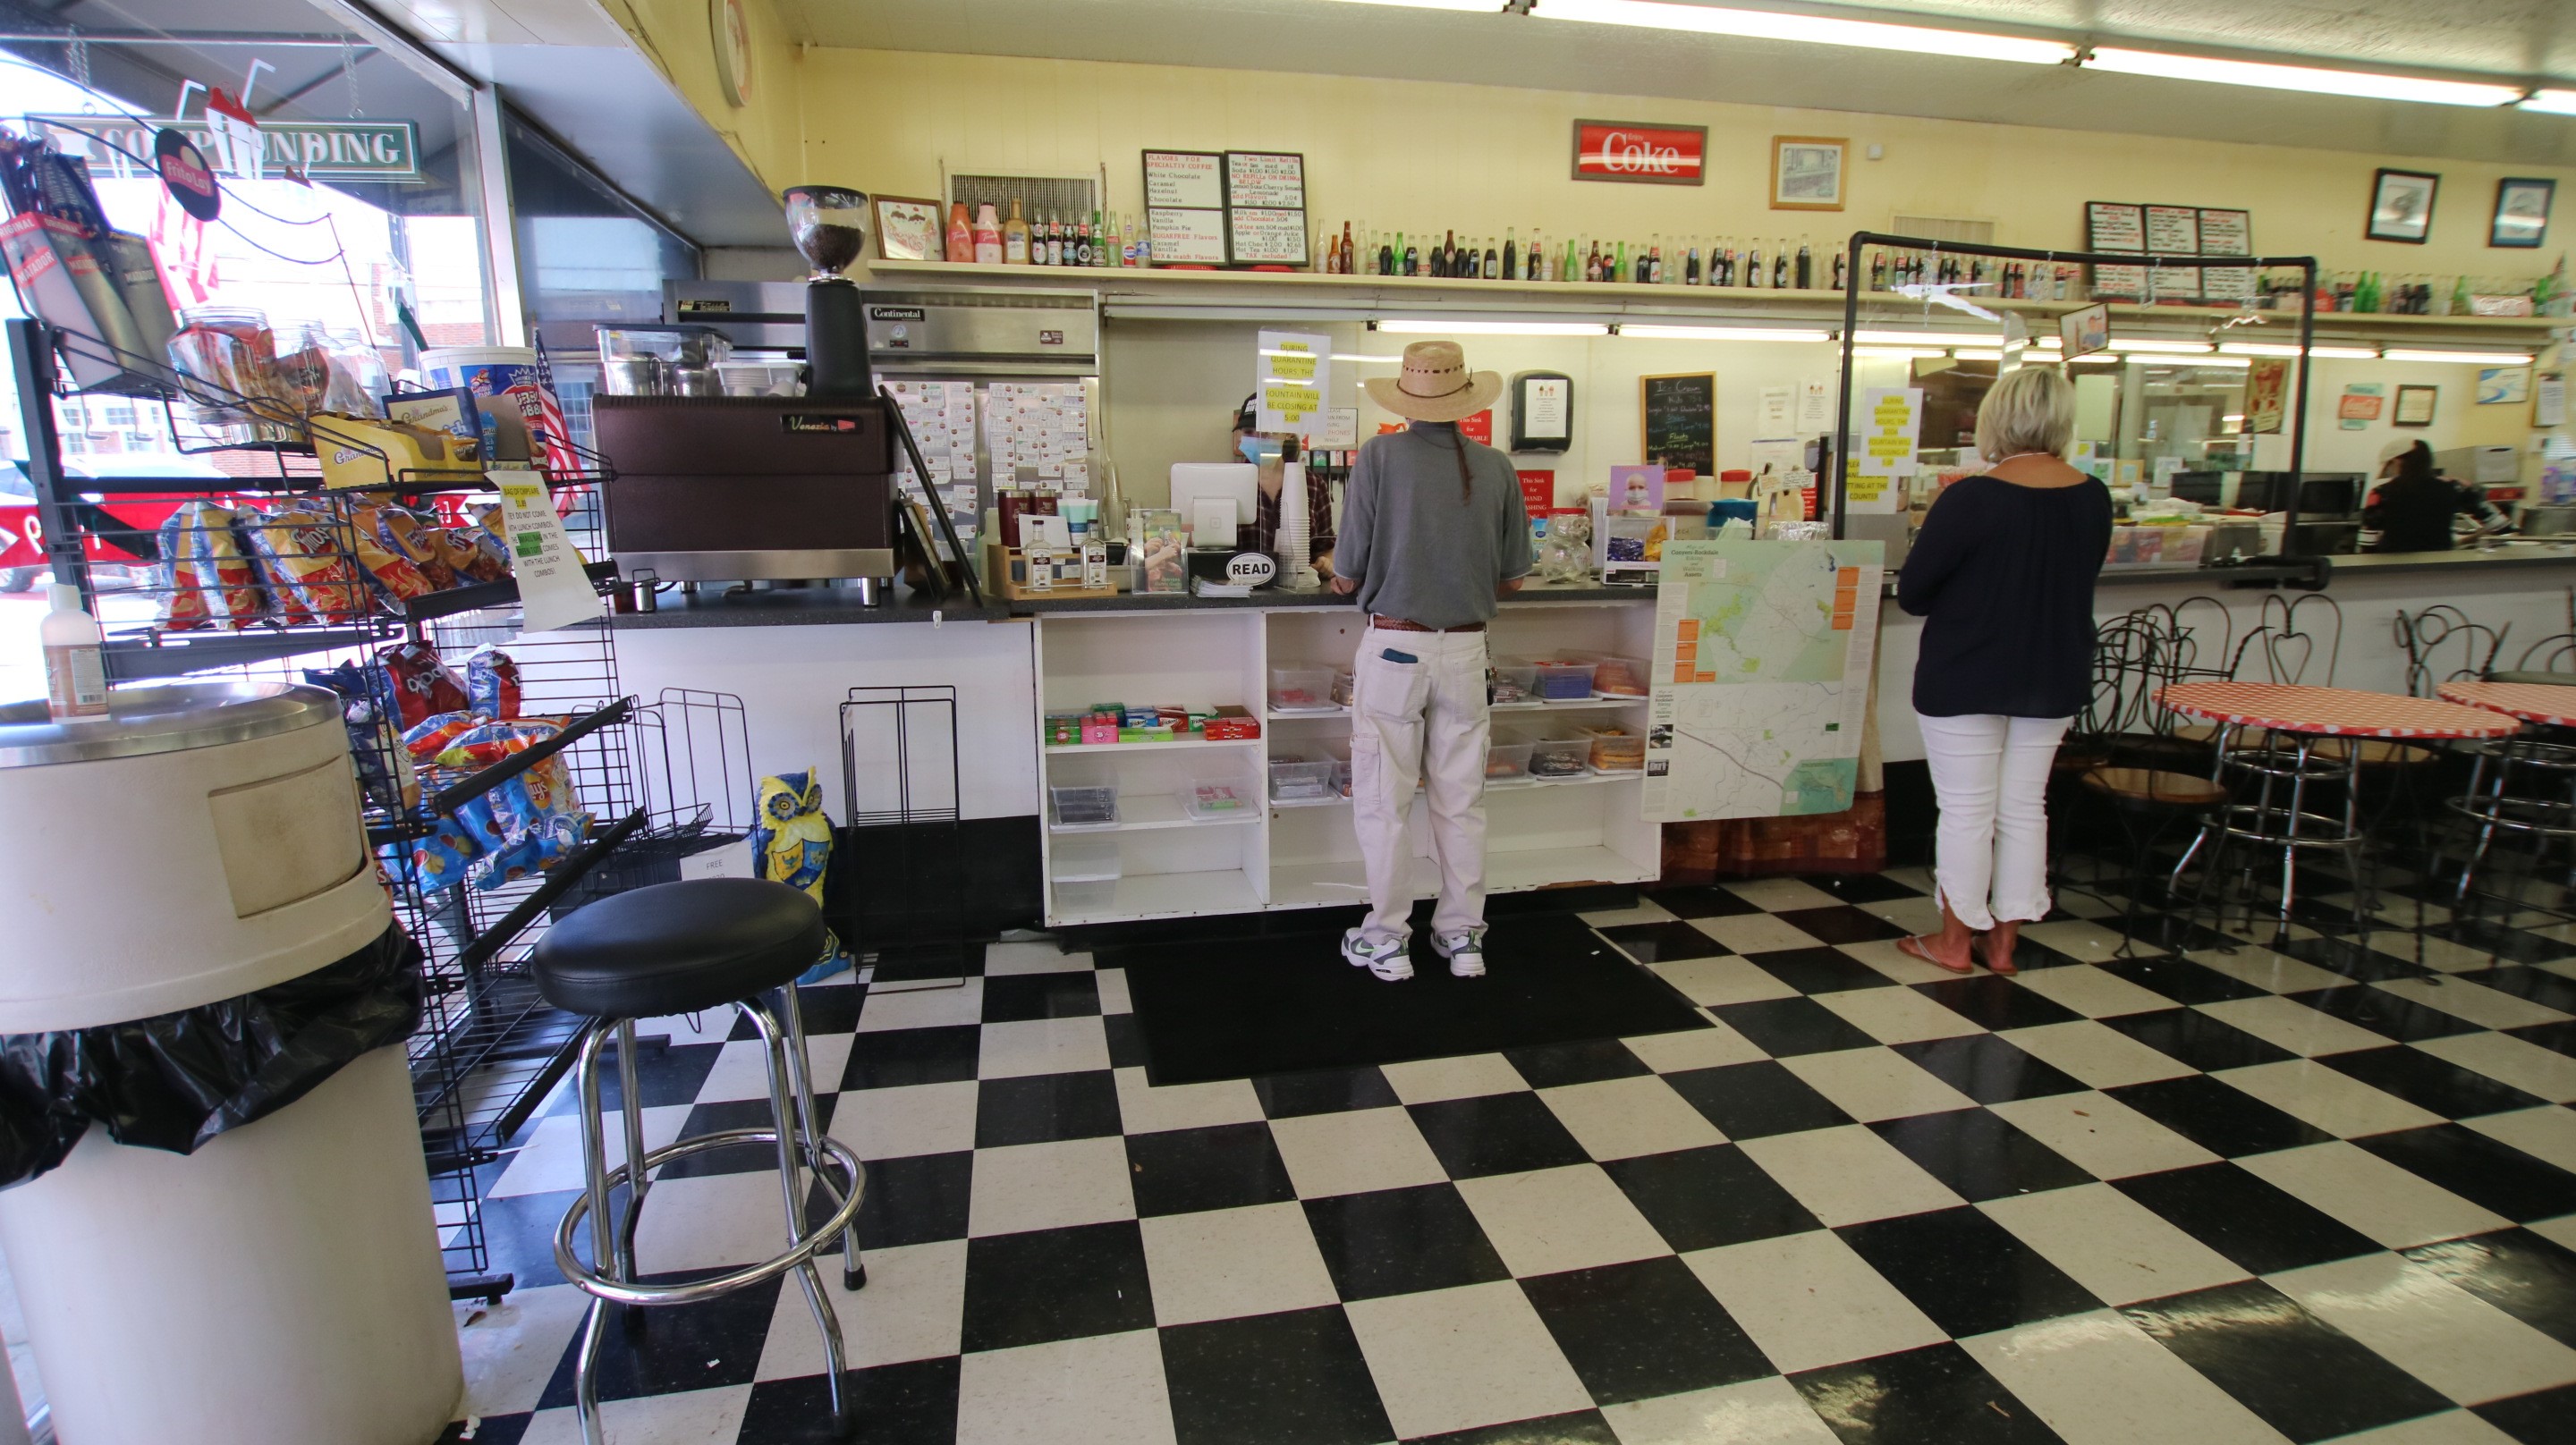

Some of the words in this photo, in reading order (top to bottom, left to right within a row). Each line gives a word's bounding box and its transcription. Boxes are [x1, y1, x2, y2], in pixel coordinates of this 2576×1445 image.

[1602, 131, 1680, 173] Coke
[0, 218, 36, 239] RIGINAL
[17, 250, 55, 286] MATADOR
[874, 308, 920, 318] Continental
[1280, 344, 1309, 352] DURING
[1270, 356, 1317, 365] QUARANTINE
[1301, 369, 1314, 377] THE
[1265, 390, 1302, 400] FOUNTAIN
[1303, 392, 1320, 401] WILL
[1277, 402, 1307, 410] CLOSING
[401, 403, 450, 425] Grandma's
[1284, 414, 1301, 422] 5:00
[789, 415, 830, 430] Venezia
[334, 444, 380, 465] Grandma
[532, 510, 547, 518] COME
[542, 544, 559, 552] COMES
[1232, 563, 1271, 575] READ
[1160, 718, 1180, 726] Trident
[706, 858, 723, 870] FREE
